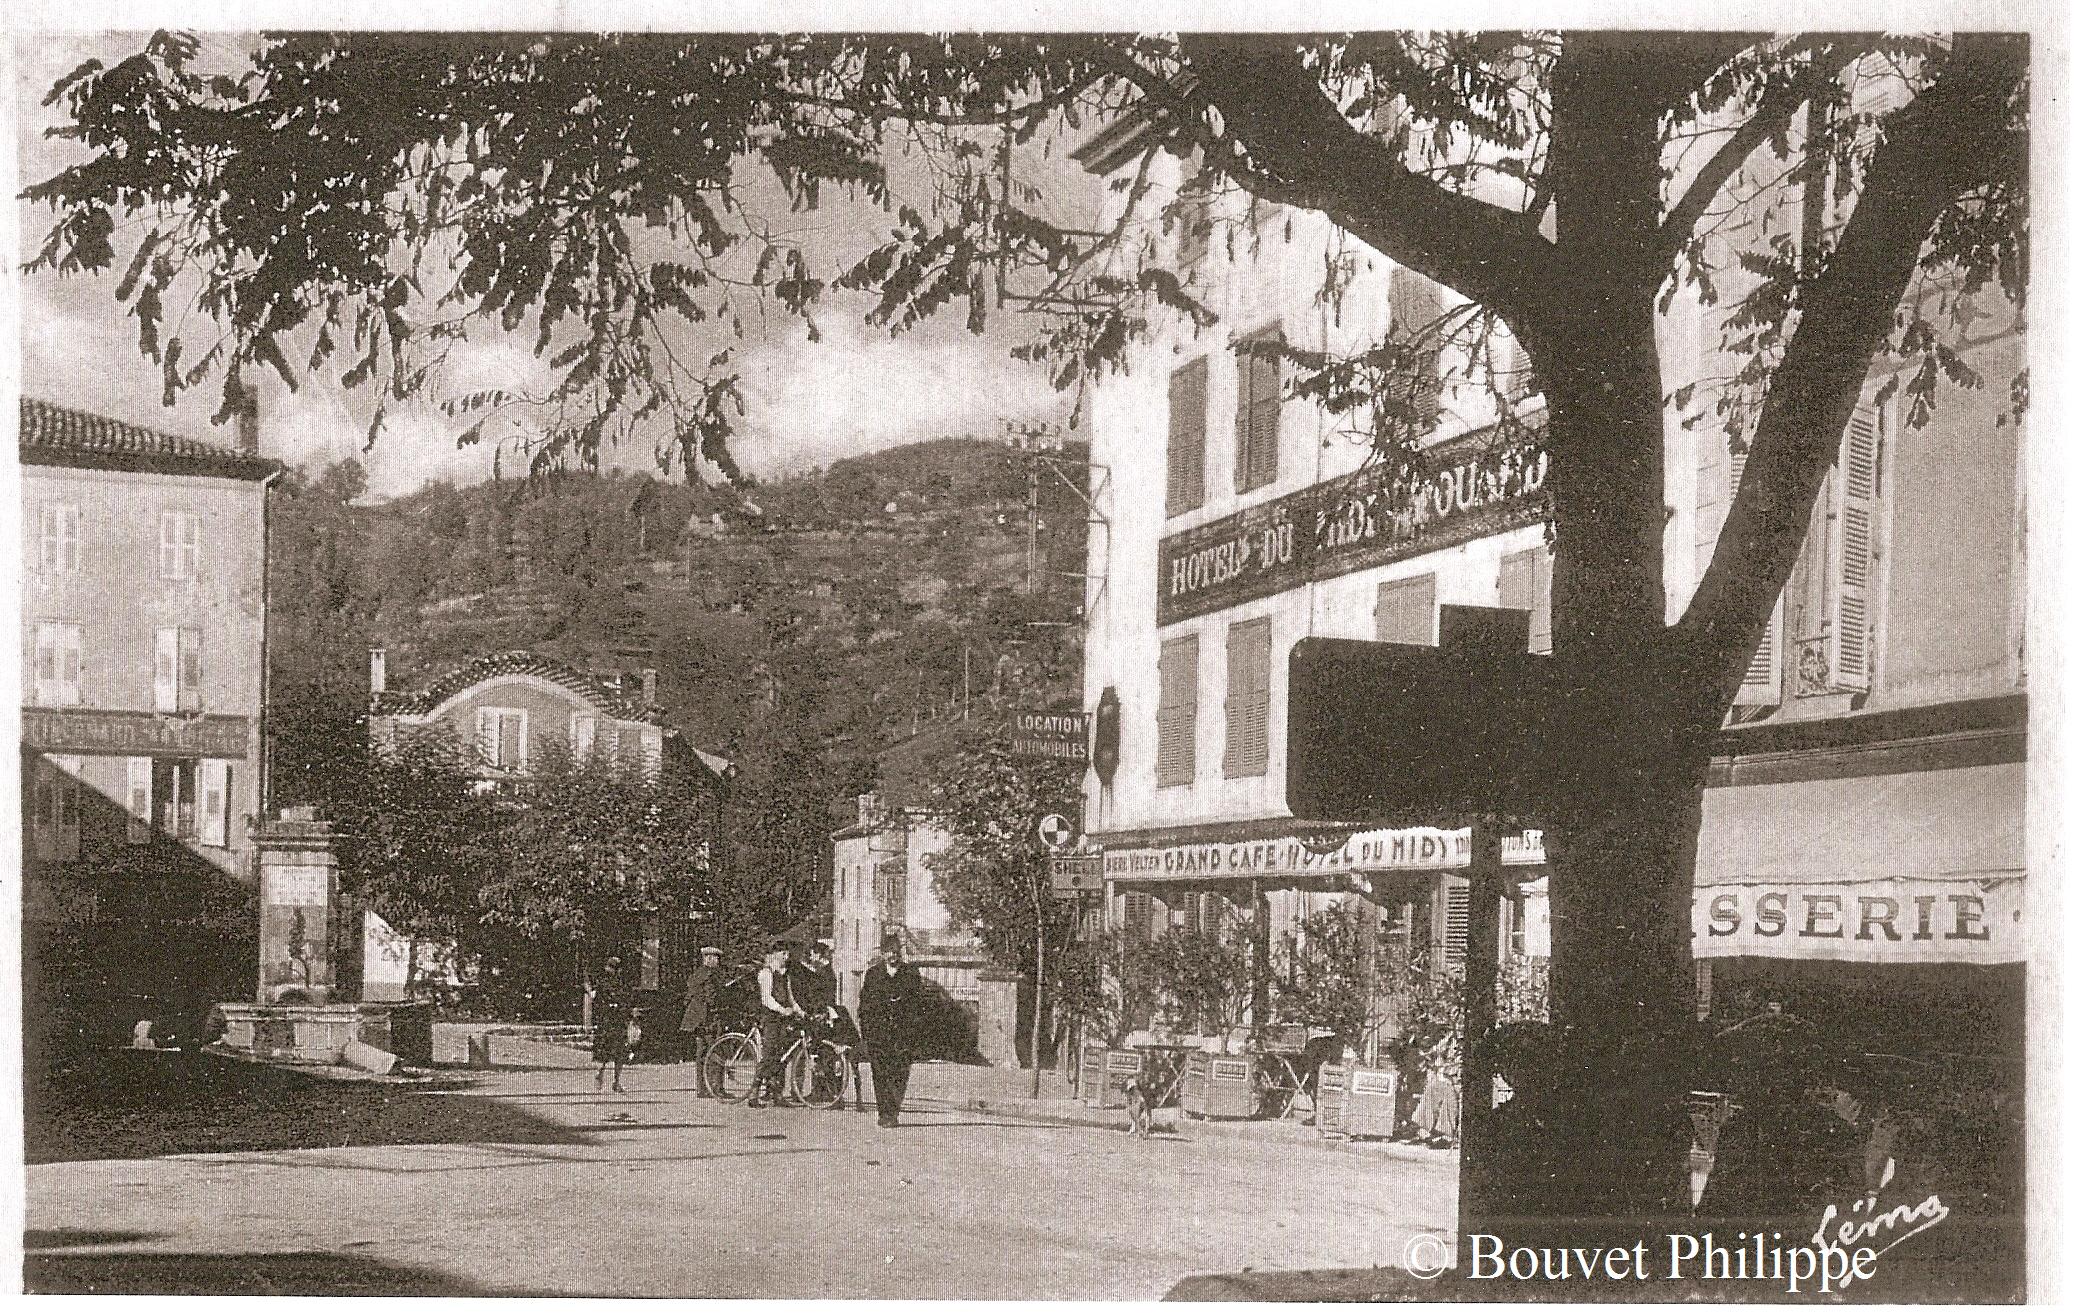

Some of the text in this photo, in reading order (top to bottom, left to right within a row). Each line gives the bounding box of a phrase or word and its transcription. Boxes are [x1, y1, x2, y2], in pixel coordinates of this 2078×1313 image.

[1171, 541, 1240, 595] HOTEL
[1263, 523, 1294, 569] DU
[1016, 714, 1082, 733] LOCATION
[1011, 739, 1086, 759] AUTOMOBILES
[1054, 861, 1096, 875] SHELL
[1164, 848, 1221, 875] GRAND
[1361, 839, 1384, 861] DU
[1691, 893, 1990, 941] SSERIE
